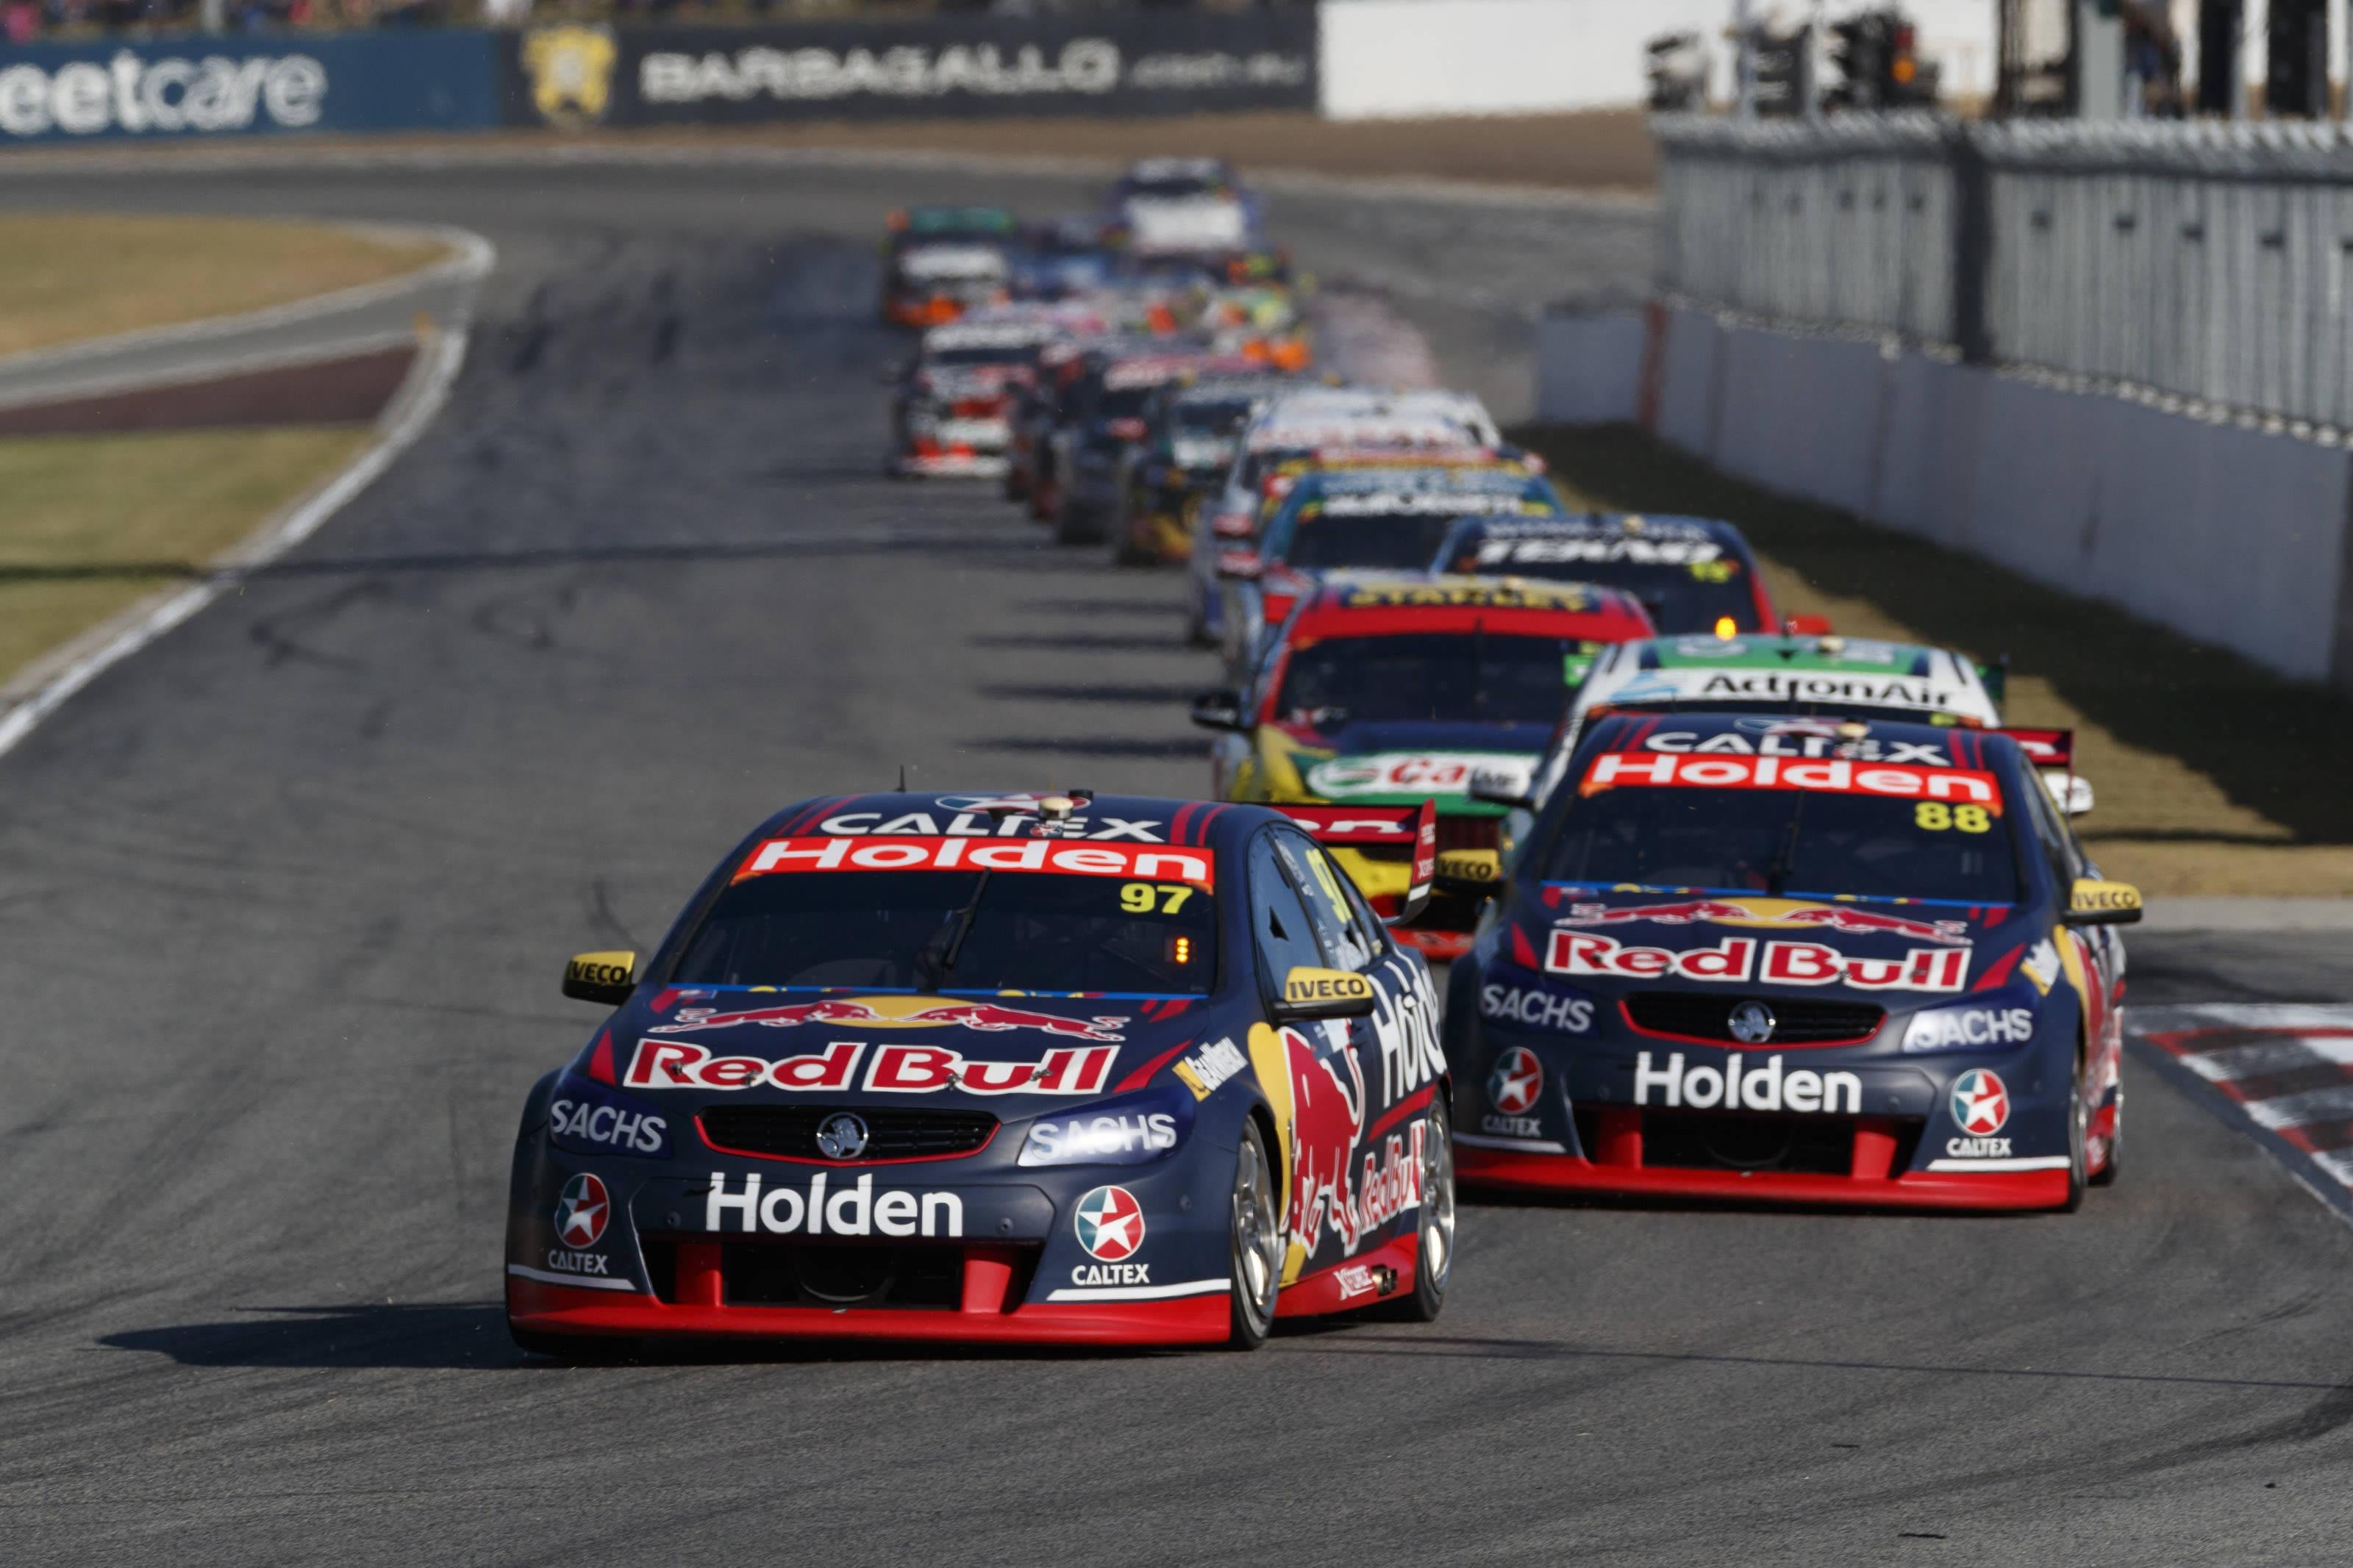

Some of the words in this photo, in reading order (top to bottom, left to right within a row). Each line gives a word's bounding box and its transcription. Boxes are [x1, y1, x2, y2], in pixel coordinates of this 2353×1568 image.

[639, 38, 1121, 103] BARBAGALLO
[0, 49, 328, 135] eetcare
[1702, 672, 1954, 706] ActronAir
[1590, 754, 1993, 801] Holden
[820, 812, 1165, 843] CALTEX
[1915, 801, 1991, 834] 88
[749, 837, 1207, 881] Holden
[1121, 883, 1194, 914] 97
[2074, 892, 2136, 909] IVECO
[565, 961, 627, 984] VECO
[1545, 928, 1757, 983] Red
[1760, 941, 1973, 992] Bull
[1289, 978, 1365, 1000] IVECO
[1481, 983, 1595, 1032] SACHS
[1912, 1008, 2033, 1048] SACHS
[622, 1037, 867, 1091] Red
[863, 1042, 1121, 1095] Bull
[1634, 1050, 1863, 1114] Holden
[549, 1099, 668, 1154] SACHS
[1028, 1112, 1177, 1161] SACHS
[1482, 1114, 1542, 1138] CALTEX
[1946, 1137, 2013, 1158] CALTEX
[706, 1172, 964, 1237] Holden
[547, 1249, 609, 1276] CALTEX
[1071, 1264, 1151, 1286] CALTEX
